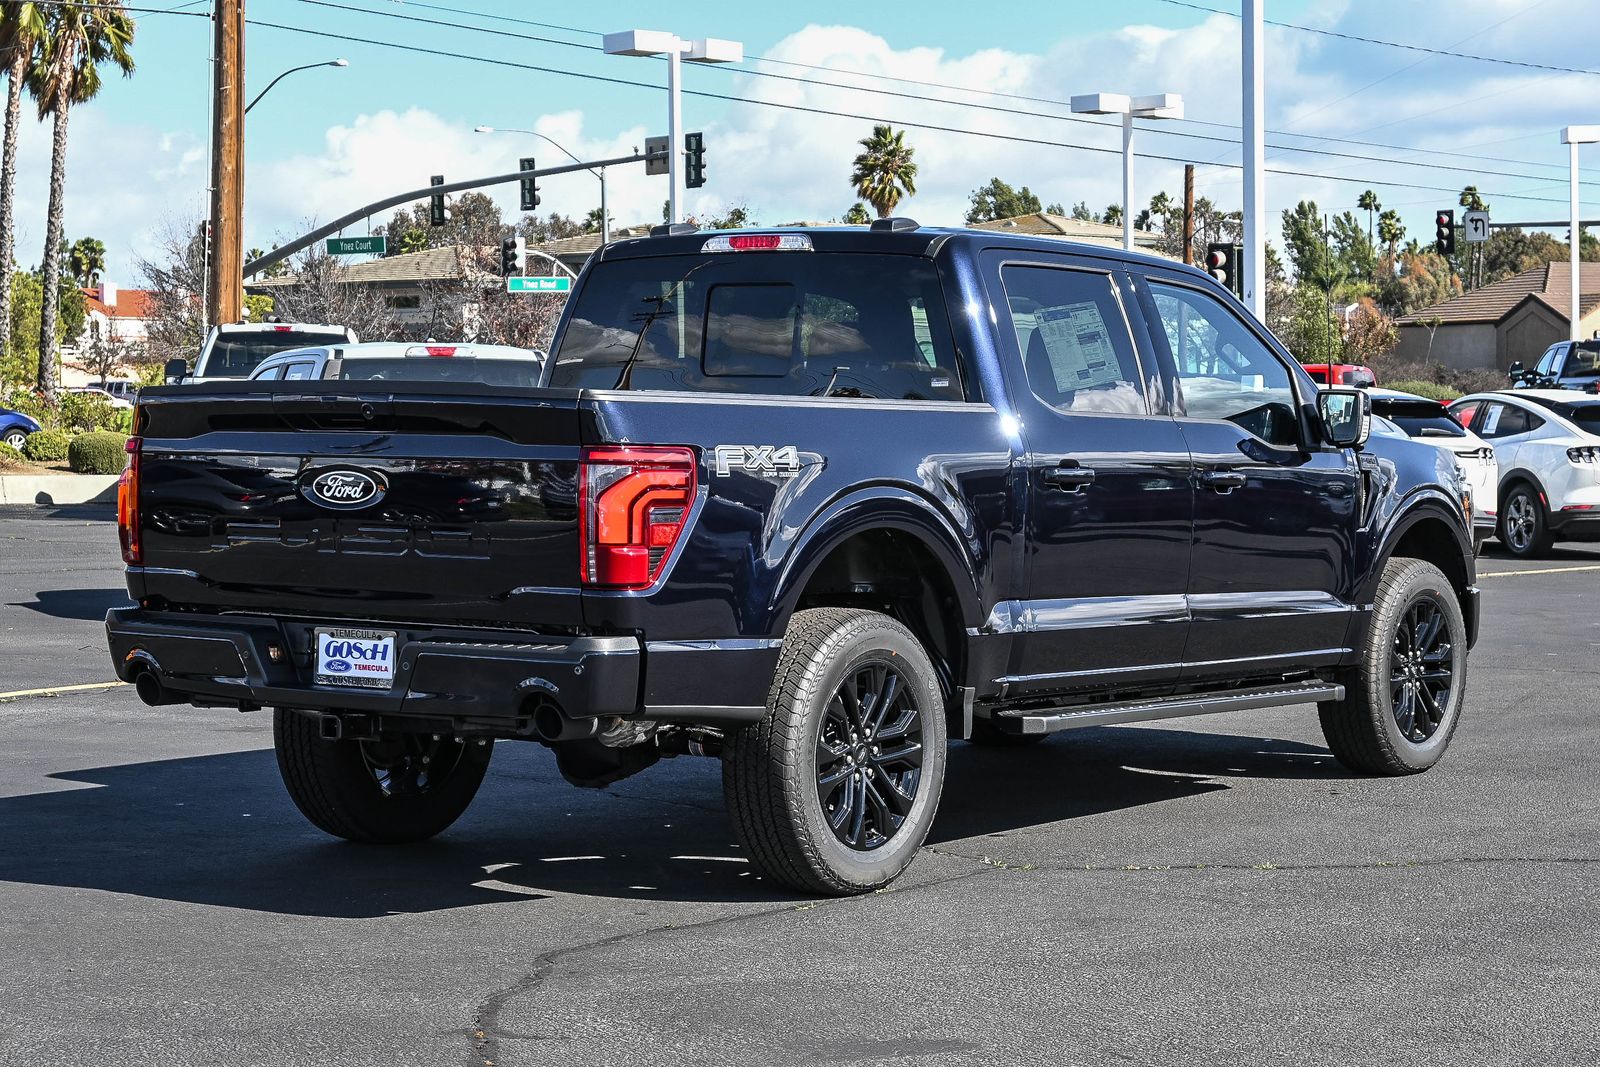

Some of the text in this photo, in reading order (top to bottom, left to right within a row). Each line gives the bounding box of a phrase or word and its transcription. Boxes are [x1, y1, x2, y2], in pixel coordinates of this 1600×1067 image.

[340, 240, 372, 250] Ynez Court
[715, 445, 799, 477] FX4
[323, 475, 365, 498] Ford
[335, 629, 377, 639] TEMECULA
[330, 661, 346, 671] Ford
[354, 664, 388, 672] TEMECULA
